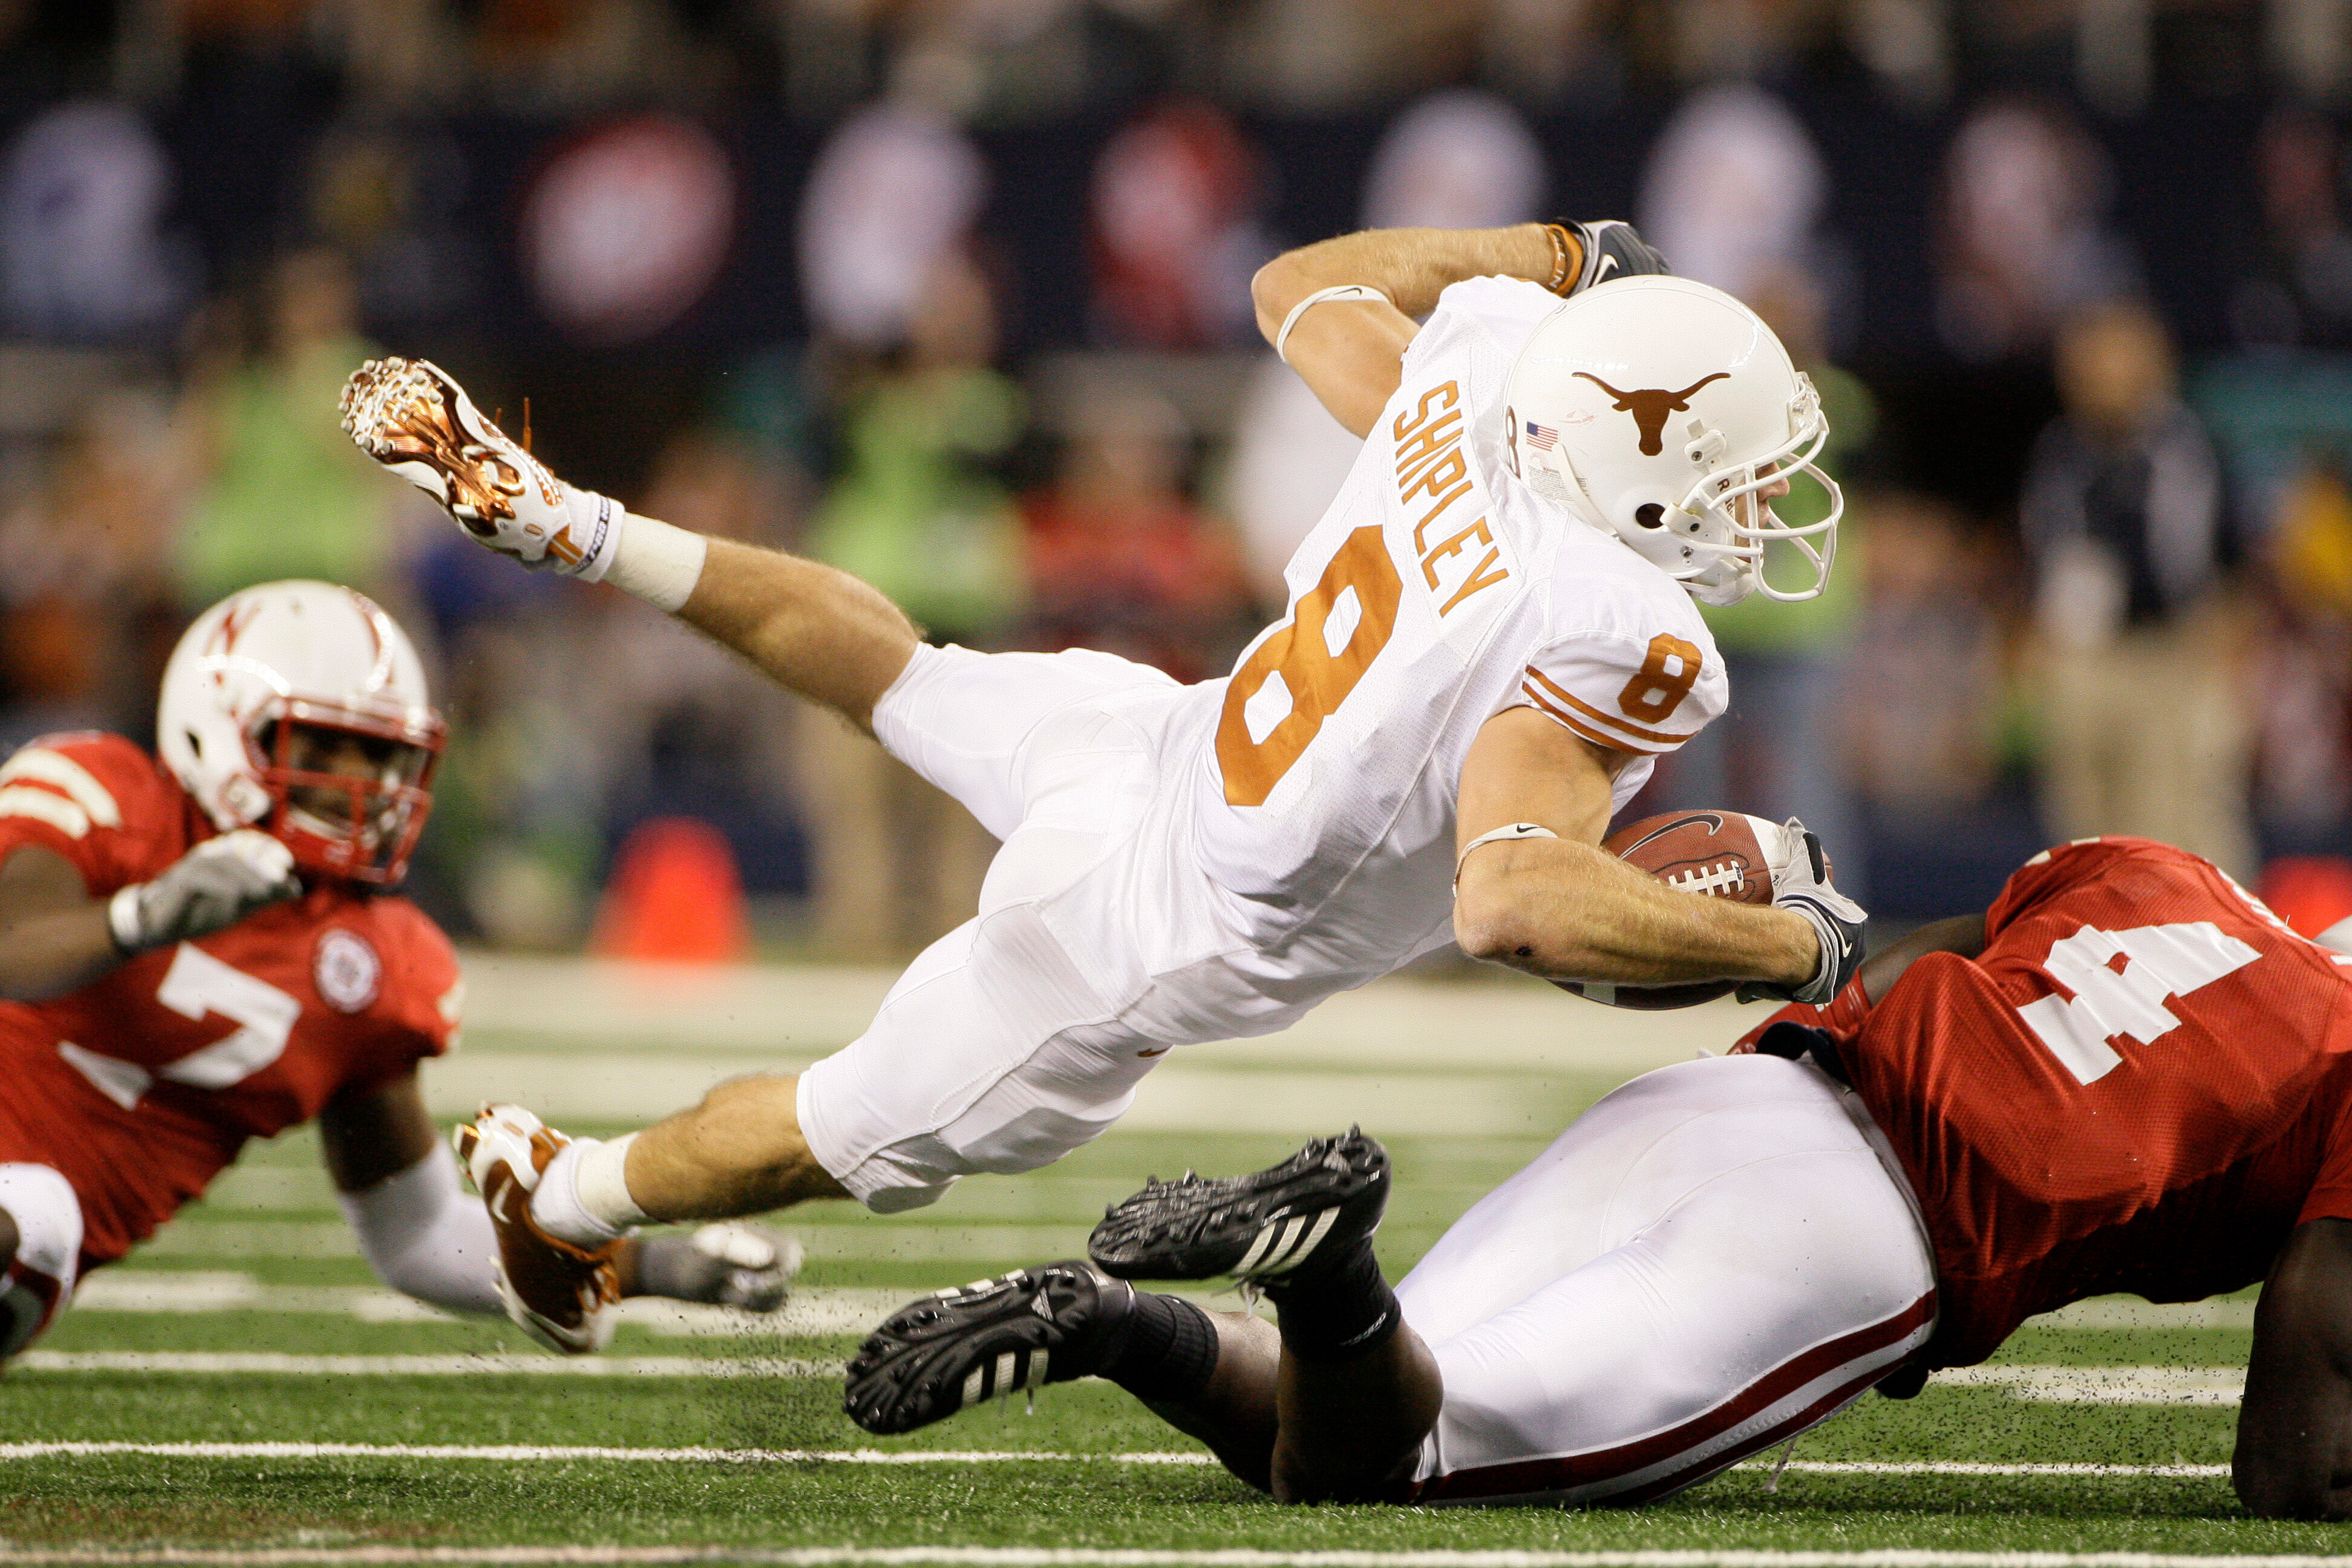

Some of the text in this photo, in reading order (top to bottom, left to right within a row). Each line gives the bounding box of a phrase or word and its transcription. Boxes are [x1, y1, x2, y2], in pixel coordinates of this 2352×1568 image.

[1393, 380, 1509, 618] SHIPLEY
[1215, 524, 1403, 806] 8
[1618, 633, 1703, 724] 8
[2016, 922, 2263, 1086] 4
